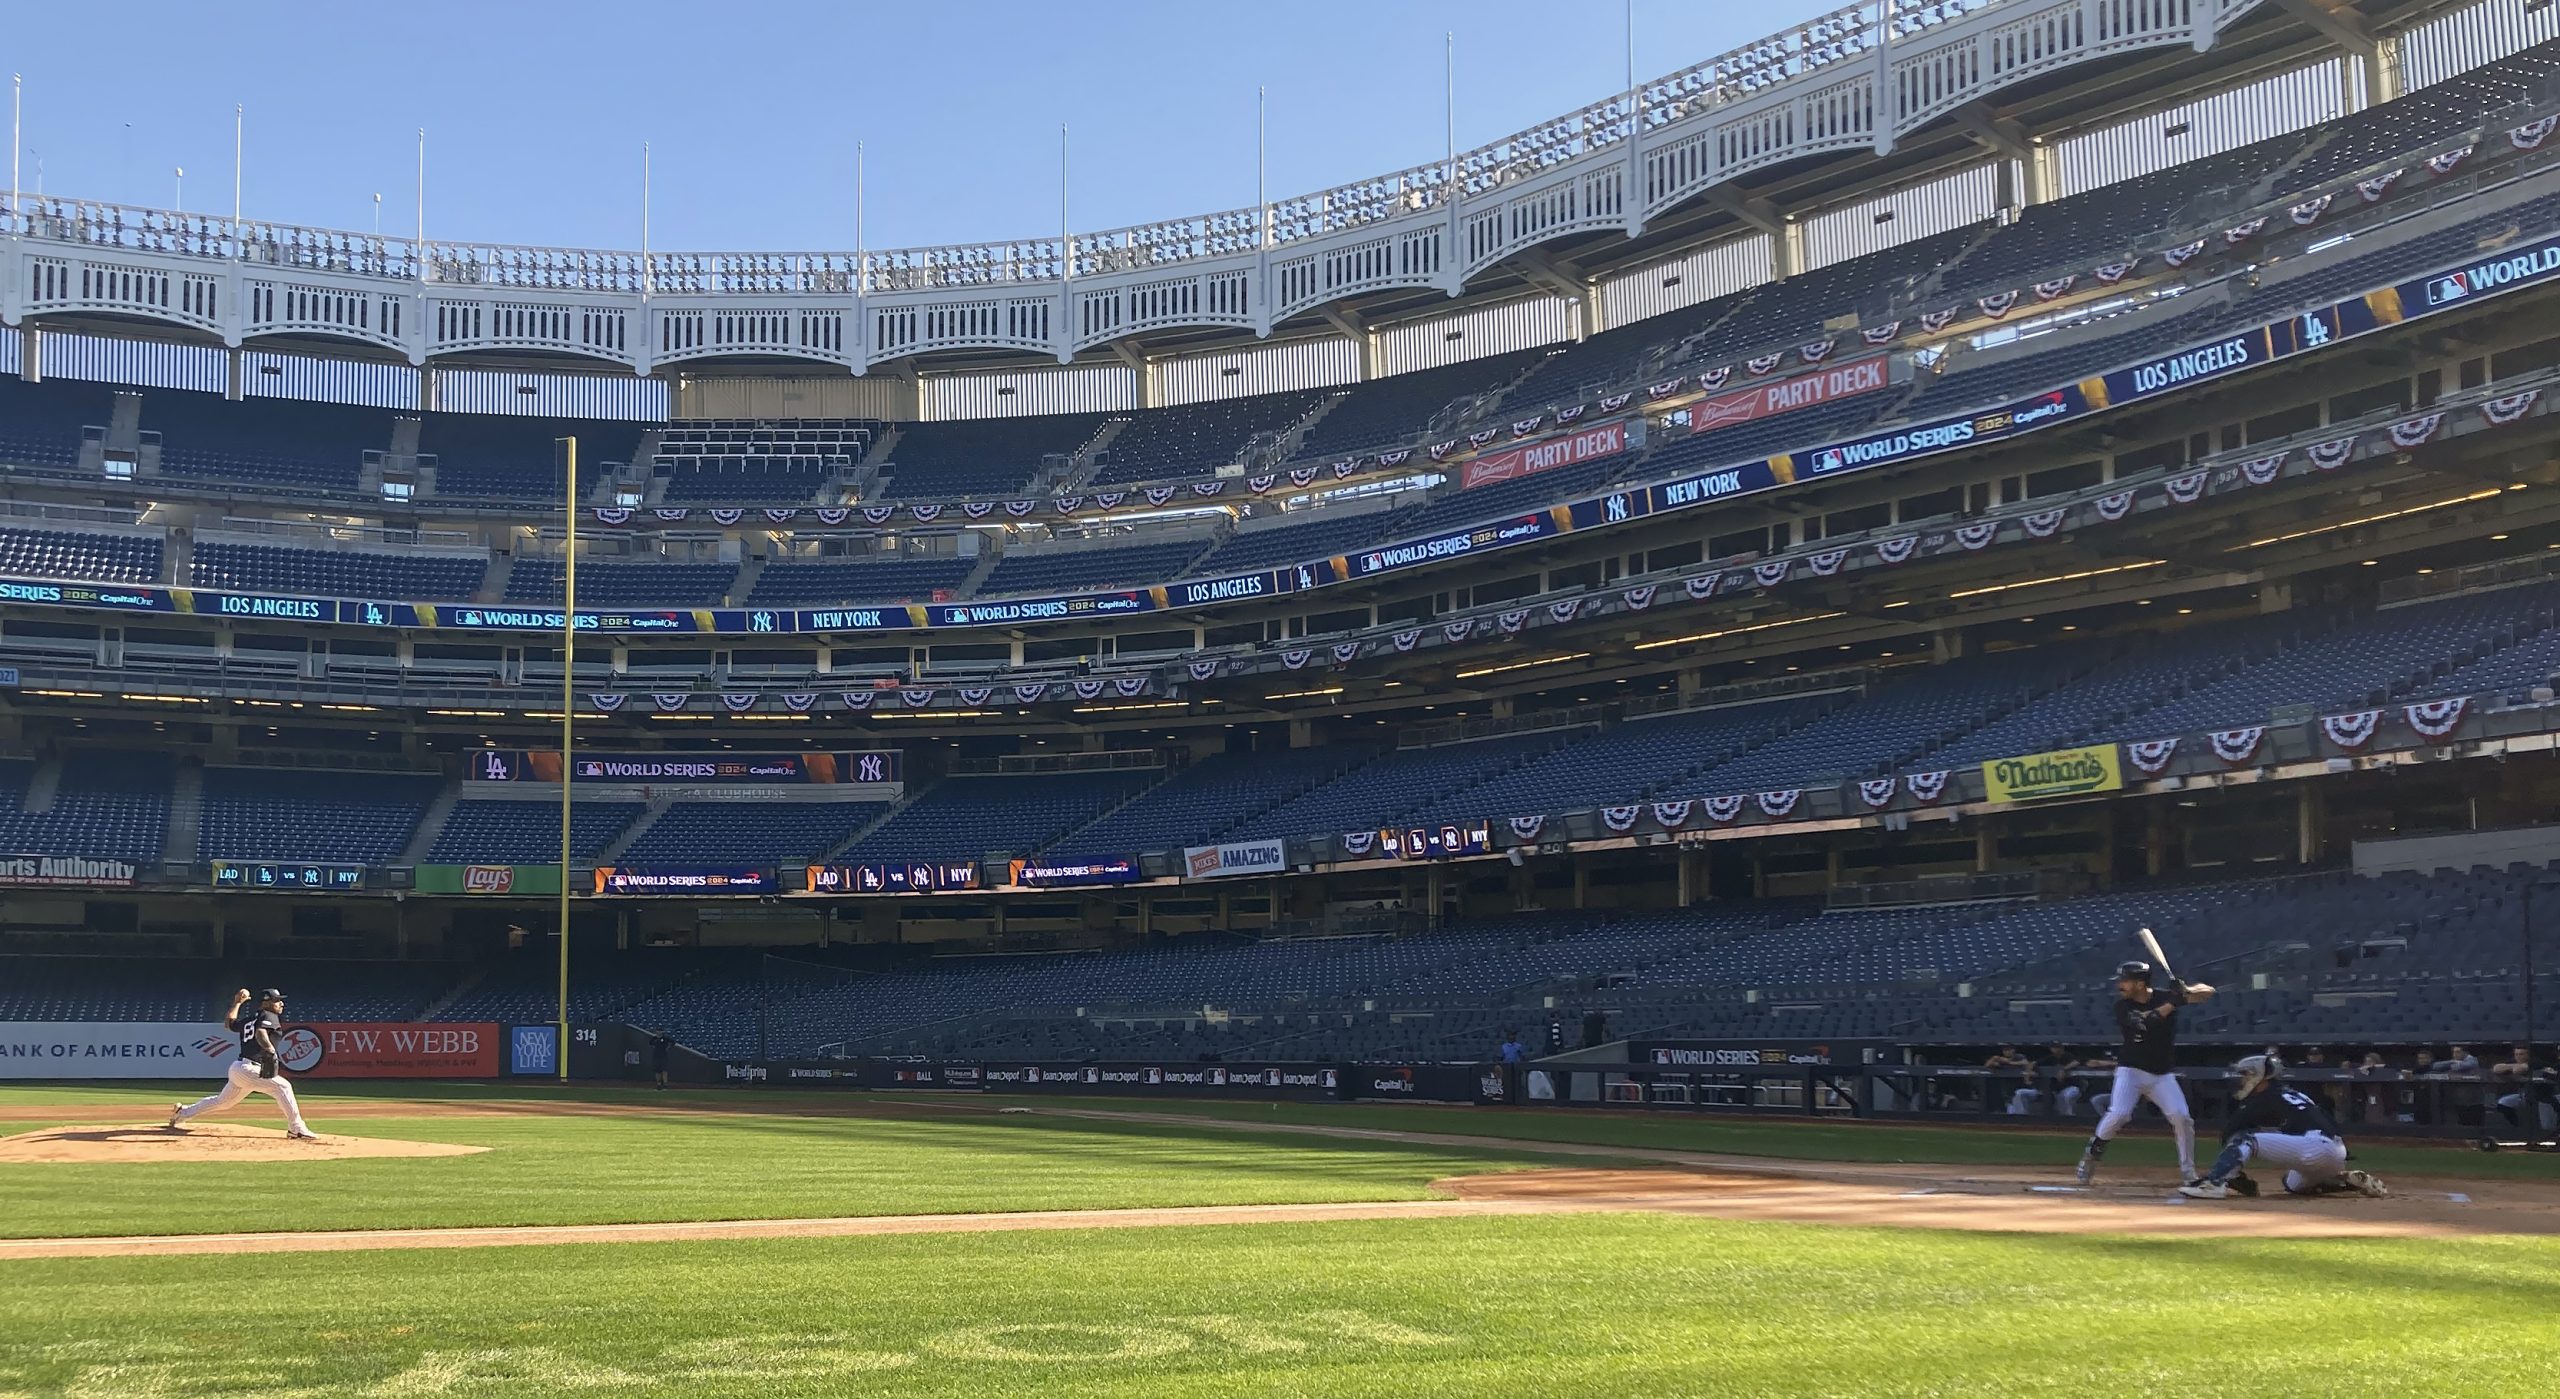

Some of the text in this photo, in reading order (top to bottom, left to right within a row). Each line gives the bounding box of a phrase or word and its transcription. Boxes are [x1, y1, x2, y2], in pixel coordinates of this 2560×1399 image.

[2468, 246, 2560, 291] WORLD
[2303, 312, 2328, 346] LA
[2134, 338, 2248, 393] LOS ANGELES
[1768, 375, 1826, 411] PARTY
[1830, 362, 1882, 396] DECK
[1525, 439, 1573, 471] PARTY
[1575, 427, 1618, 458] DECK
[1841, 436, 1908, 465] WORLD
[1909, 421, 1975, 450] SERIES
[1974, 414, 2013, 432] 2024
[2215, 468, 2239, 486] 1939
[1665, 471, 1741, 505] NEW YORK
[1607, 494, 1628, 521] NY
[1381, 545, 1427, 566] WORLD
[1428, 534, 1471, 557] SERIES
[1472, 530, 1498, 544] 2024
[1298, 566, 1312, 588] LA
[0, 583, 60, 601] SERIES
[63, 590, 97, 600] 2024
[1187, 576, 1262, 602] LOS ANGELES
[222, 597, 319, 617] LOS ANGELES
[367, 603, 382, 625] LA
[969, 605, 1020, 621] WORLD
[1021, 601, 1068, 618] SERIES
[1069, 601, 1095, 611] 2024
[483, 610, 543, 626] WORLD
[544, 613, 599, 629] SEIES
[600, 616, 631, 627] 2024
[753, 611, 773, 631] NY
[813, 611, 881, 628] NEW YORK
[486, 751, 507, 780] LA
[606, 762, 662, 776] WORLD
[664, 763, 715, 777] SERIES
[717, 765, 747, 774] 2024
[859, 754, 884, 781] NY
[1995, 752, 2104, 789] Nathan's
[1383, 838, 1398, 851] LAD
[1412, 834, 1423, 849] LA
[1429, 836, 1439, 844] vs
[1471, 830, 1488, 842] NYY
[1222, 845, 1281, 868] AMAZING
[40, 856, 135, 880] Authority
[220, 869, 238, 879] LAD
[261, 867, 272, 882] LA
[339, 871, 359, 882] NYY
[865, 867, 929, 887] LA vs NY
[951, 868, 972, 882] NYY
[1035, 867, 1062, 877] WORLD
[1063, 866, 1089, 876] SERIES
[627, 875, 668, 886] WORLD
[669, 875, 706, 887] SERIES
[707, 877, 728, 885] 2024
[816, 871, 838, 886] LAD
[328, 1030, 479, 1054] F.W. WEBB
[520, 1032, 549, 1044] NEW
[576, 1029, 597, 1041] 314
[0, 1044, 186, 1057] ANK OF AMERICA
[515, 1043, 552, 1056] YORK
[1671, 1050, 1715, 1065] WORLD
[1715, 1050, 1760, 1065] SERIES
[520, 1055, 548, 1068] LIFE
